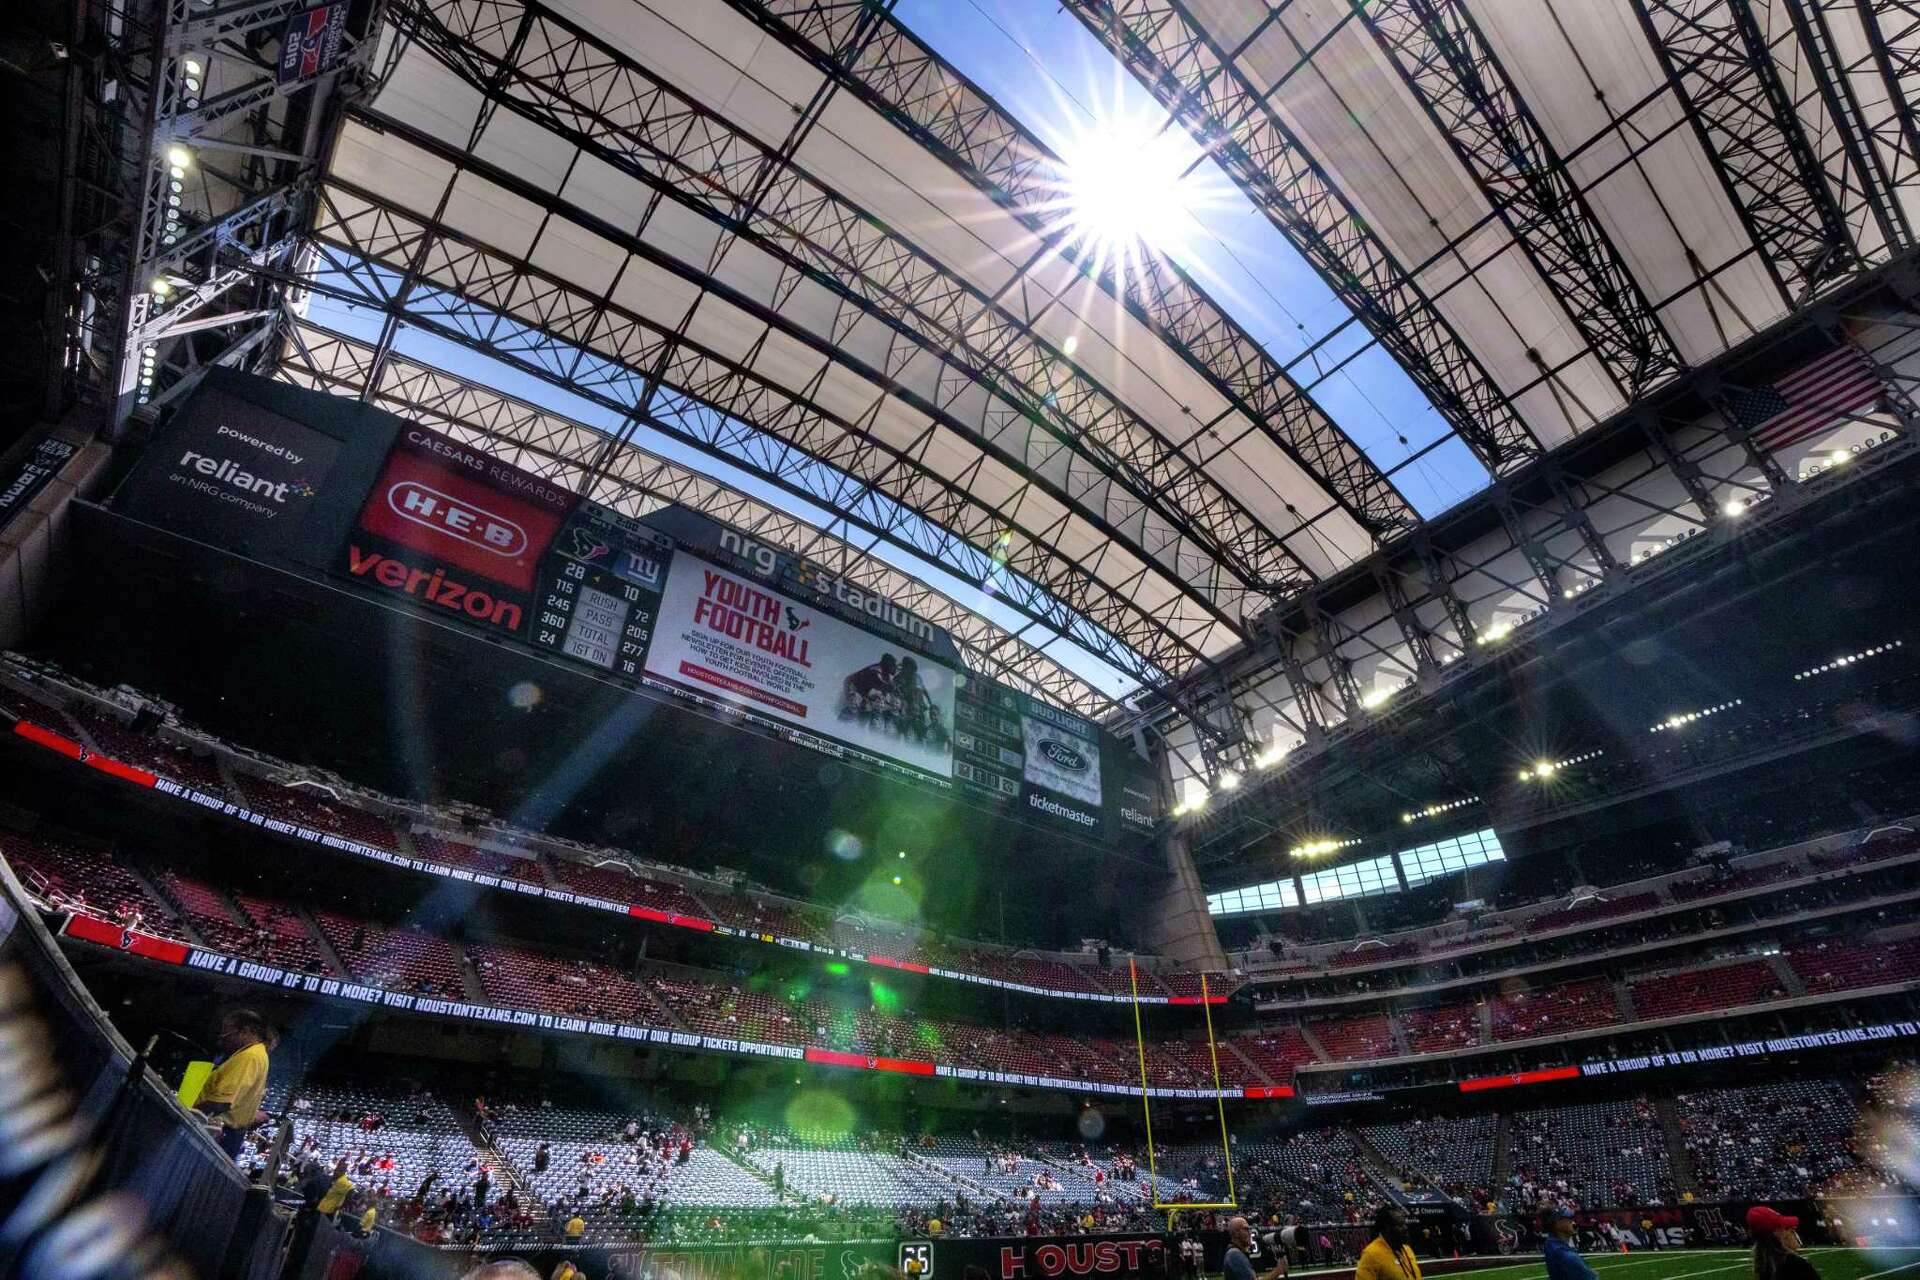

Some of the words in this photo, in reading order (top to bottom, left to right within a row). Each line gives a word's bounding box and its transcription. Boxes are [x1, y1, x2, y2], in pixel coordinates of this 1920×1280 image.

[284, 32, 301, 68] 2019
[217, 425, 286, 457] powered
[284, 450, 304, 465] by
[180, 450, 289, 503] reliant
[407, 431, 486, 472] CAESARS
[490, 464, 568, 507] REWARDS
[169, 473, 187, 485] an
[187, 477, 219, 496] NRG
[219, 491, 278, 519] company
[403, 490, 514, 547] H-E-B
[564, 562, 586, 580] 28
[719, 528, 776, 576] nrg
[814, 571, 935, 642] stadium
[349, 544, 523, 631] verizon
[555, 578, 575, 594] 115
[624, 585, 640, 601] 10
[704, 569, 781, 626] YOUTH
[547, 595, 571, 612] 245
[590, 592, 618, 612] RUSH
[635, 609, 649, 624] 72
[541, 612, 566, 630] 360
[585, 609, 613, 627] PASS
[626, 624, 649, 641] 205
[693, 597, 812, 668] FOOTBALL
[539, 630, 556, 645] 24
[578, 625, 609, 646] TOTAL
[622, 641, 644, 657] 277
[691, 629, 709, 641] SIGN
[709, 634, 720, 644] UP
[720, 638, 735, 650] FOR
[735, 644, 751, 657] OUR
[752, 651, 774, 665] YOUTH
[623, 660, 636, 674] 16
[681, 633, 729, 656] NEWSLETTER
[728, 650, 746, 661] FOR
[800, 678, 815, 690] AND
[690, 643, 708, 656] HOW
[709, 650, 719, 659] TO
[719, 654, 734, 666] GET
[705, 656, 729, 671] YOUTH
[729, 664, 766, 685] FOOTBALL
[1056, 712, 1088, 735] LIGHT
[1048, 743, 1079, 768] Ford
[1029, 793, 1097, 827] ticketmaster
[1121, 806, 1154, 829] reliant
[155, 778, 182, 797] HAVE
[182, 788, 190, 800] A
[190, 792, 224, 811] GROUP
[224, 803, 238, 816] OF
[238, 808, 250, 821] 10
[250, 813, 264, 826] OR
[264, 819, 297, 837] MORE?
[296, 828, 321, 843] VISIT
[321, 835, 410, 869] HOUSTONTEXANS.COM
[412, 860, 423, 871] TO
[423, 863, 451, 877] LEARN
[450, 868, 474, 882] MORE
[474, 873, 500, 888] ABOUT
[500, 879, 517, 892] OUR
[517, 882, 544, 897] GROUP
[544, 888, 574, 903] TICKETS
[189, 950, 226, 971] HAVE
[226, 958, 236, 974] A
[238, 962, 283, 984] GROUP
[282, 972, 302, 988] OF
[304, 975, 320, 992] 10
[320, 980, 339, 996] OR
[340, 983, 384, 1004] MORE?
[384, 992, 415, 1010] VISIT
[415, 998, 537, 1026] HOUSTONTEXANS.COM
[538, 1014, 552, 1028] TO
[554, 1016, 587, 1033] LEARN
[588, 1021, 616, 1036] MORE
[617, 1026, 649, 1041] ABOUT
[650, 1030, 670, 1044] OUR
[670, 1032, 701, 1047] GROUP
[702, 1036, 738, 1052] TICKETS
[739, 1042, 804, 1060] OPPORTUNITIES!
[1582, 1062, 1608, 1076] HAVE
[1608, 1060, 1617, 1072] A
[1618, 1057, 1650, 1071] GROUP
[1652, 1054, 1666, 1067] OF
[1668, 1052, 1681, 1065] 10
[1682, 1050, 1698, 1063] OR
[1698, 1047, 1734, 1061] MORE?
[1734, 1042, 1764, 1056] VISIT
[1765, 1025, 1897, 1053] HOUSTONTEXANS.COM
[1896, 1022, 1917, 1036] TO
[936, 1065, 952, 1076] HAVE
[958, 1068, 978, 1078] GROUP
[979, 1070, 987, 1080] OF
[988, 1072, 994, 1081] 10
[996, 1072, 1004, 1082] OR
[1004, 1074, 1023, 1084] MORE?
[1024, 1075, 1038, 1085] VISIT
[1038, 1077, 1094, 1091] HOUSTONTEXANS.COM
[1100, 1083, 1116, 1092] LEARN
[1116, 1086, 1129, 1094] MORE
[1130, 1086, 1144, 1095] ABOUT
[1156, 1088, 1174, 1097] GROUP
[1175, 1088, 1197, 1098] TICKETS
